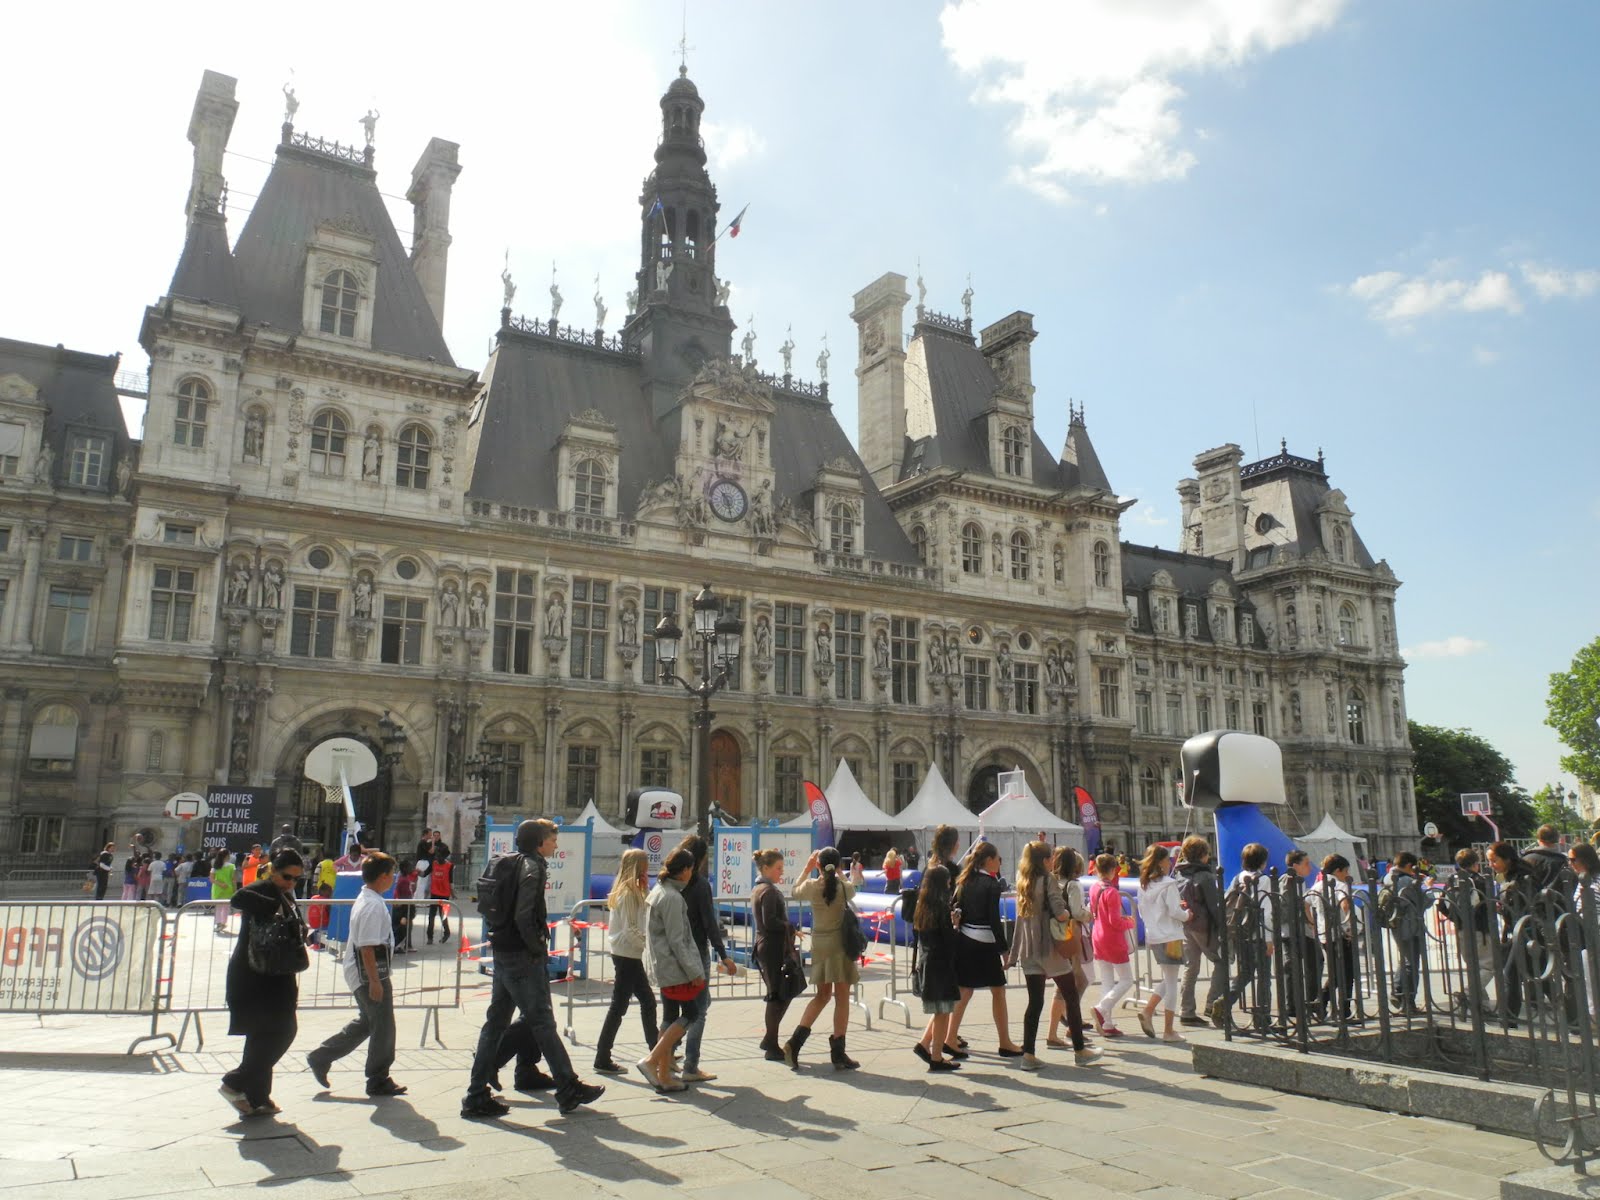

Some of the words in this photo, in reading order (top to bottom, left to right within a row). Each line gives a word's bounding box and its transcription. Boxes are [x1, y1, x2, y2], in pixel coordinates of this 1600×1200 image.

[208, 793, 253, 805] ARCHIVES
[207, 808, 219, 819] DE
[221, 808, 233, 819] LA
[235, 808, 250, 819] VIE
[205, 821, 259, 834] LITTÉRAIRE
[203, 836, 227, 848] SOUS
[722, 867, 732, 879] de
[544, 881, 564, 890] aris
[722, 881, 740, 894] Paris
